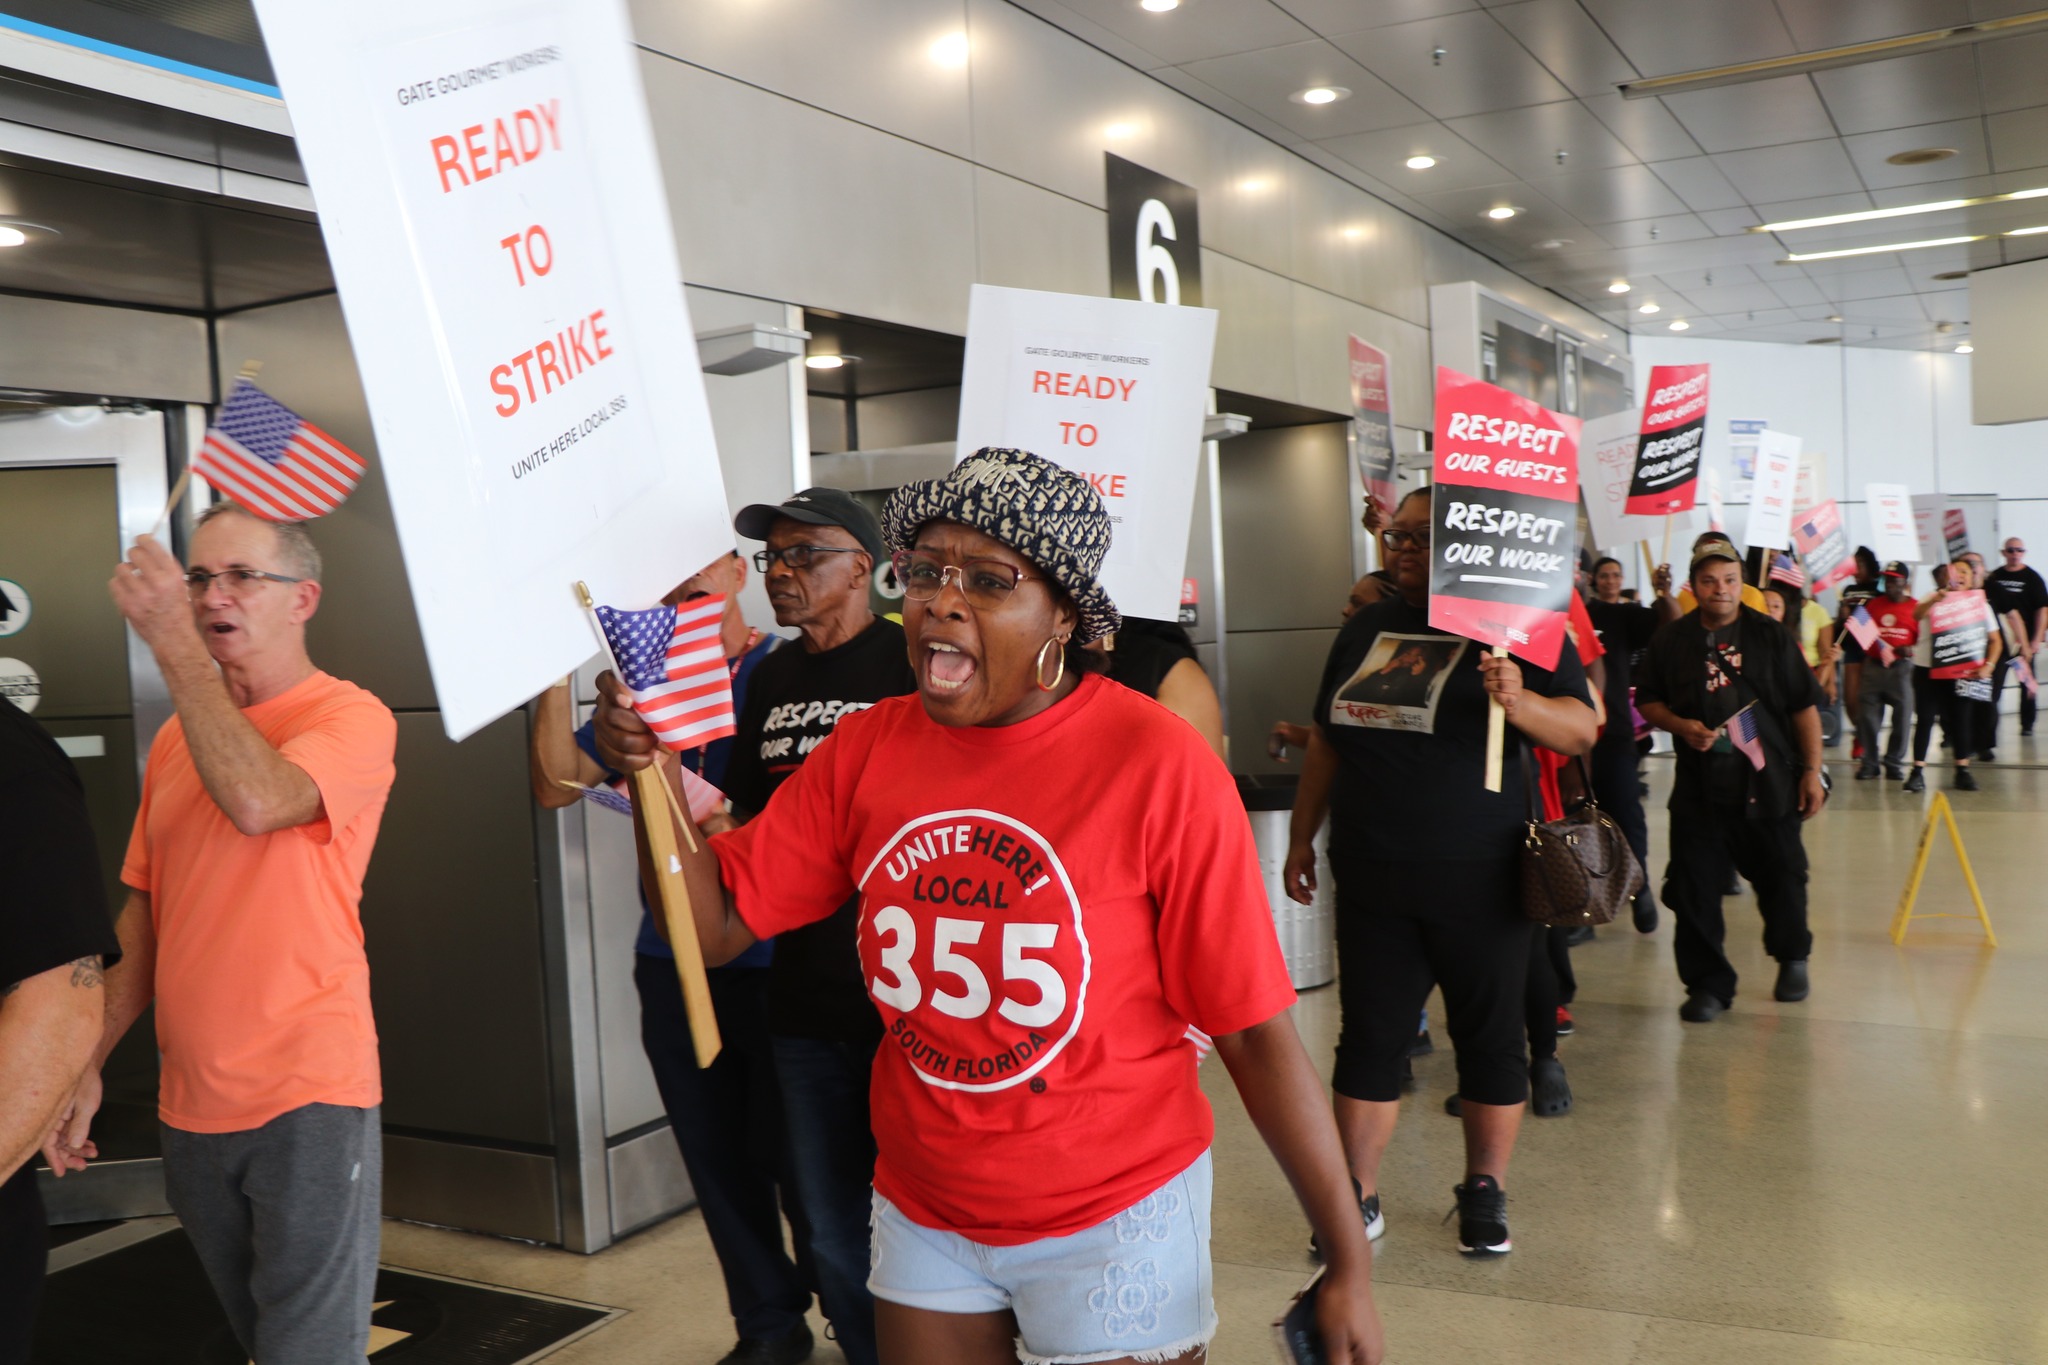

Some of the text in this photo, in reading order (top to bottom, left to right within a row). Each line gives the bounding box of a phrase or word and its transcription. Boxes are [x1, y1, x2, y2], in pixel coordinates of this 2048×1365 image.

[397, 81, 436, 106] GATE
[437, 61, 503, 94] GOURMET
[430, 99, 562, 193] READY
[500, 224, 553, 287] TO
[1136, 199, 1181, 306] 6
[490, 309, 614, 418] STRIKE
[1024, 346, 1151, 366] GATE GOURMET WORKERS
[1033, 370, 1138, 402] READY
[512, 446, 549, 480] UNITE
[550, 427, 579, 458] HERE
[579, 406, 610, 438] LOCAL
[1059, 421, 1099, 447] TO
[1447, 411, 1566, 456] RESPECT
[1596, 443, 1638, 464] READ
[1641, 426, 1704, 460] RESPECT
[1444, 452, 1568, 485] OUR GUESTS
[1638, 460, 1670, 479] OUR
[1444, 501, 1565, 547] RESPECT
[1444, 542, 1566, 574] OUR WORK
[760, 736, 794, 760] OUR
[913, 874, 1009, 909] LOCAL
[871, 905, 1067, 1028] 355
[890, 1017, 1048, 1079] SOUTH FLORIDA
